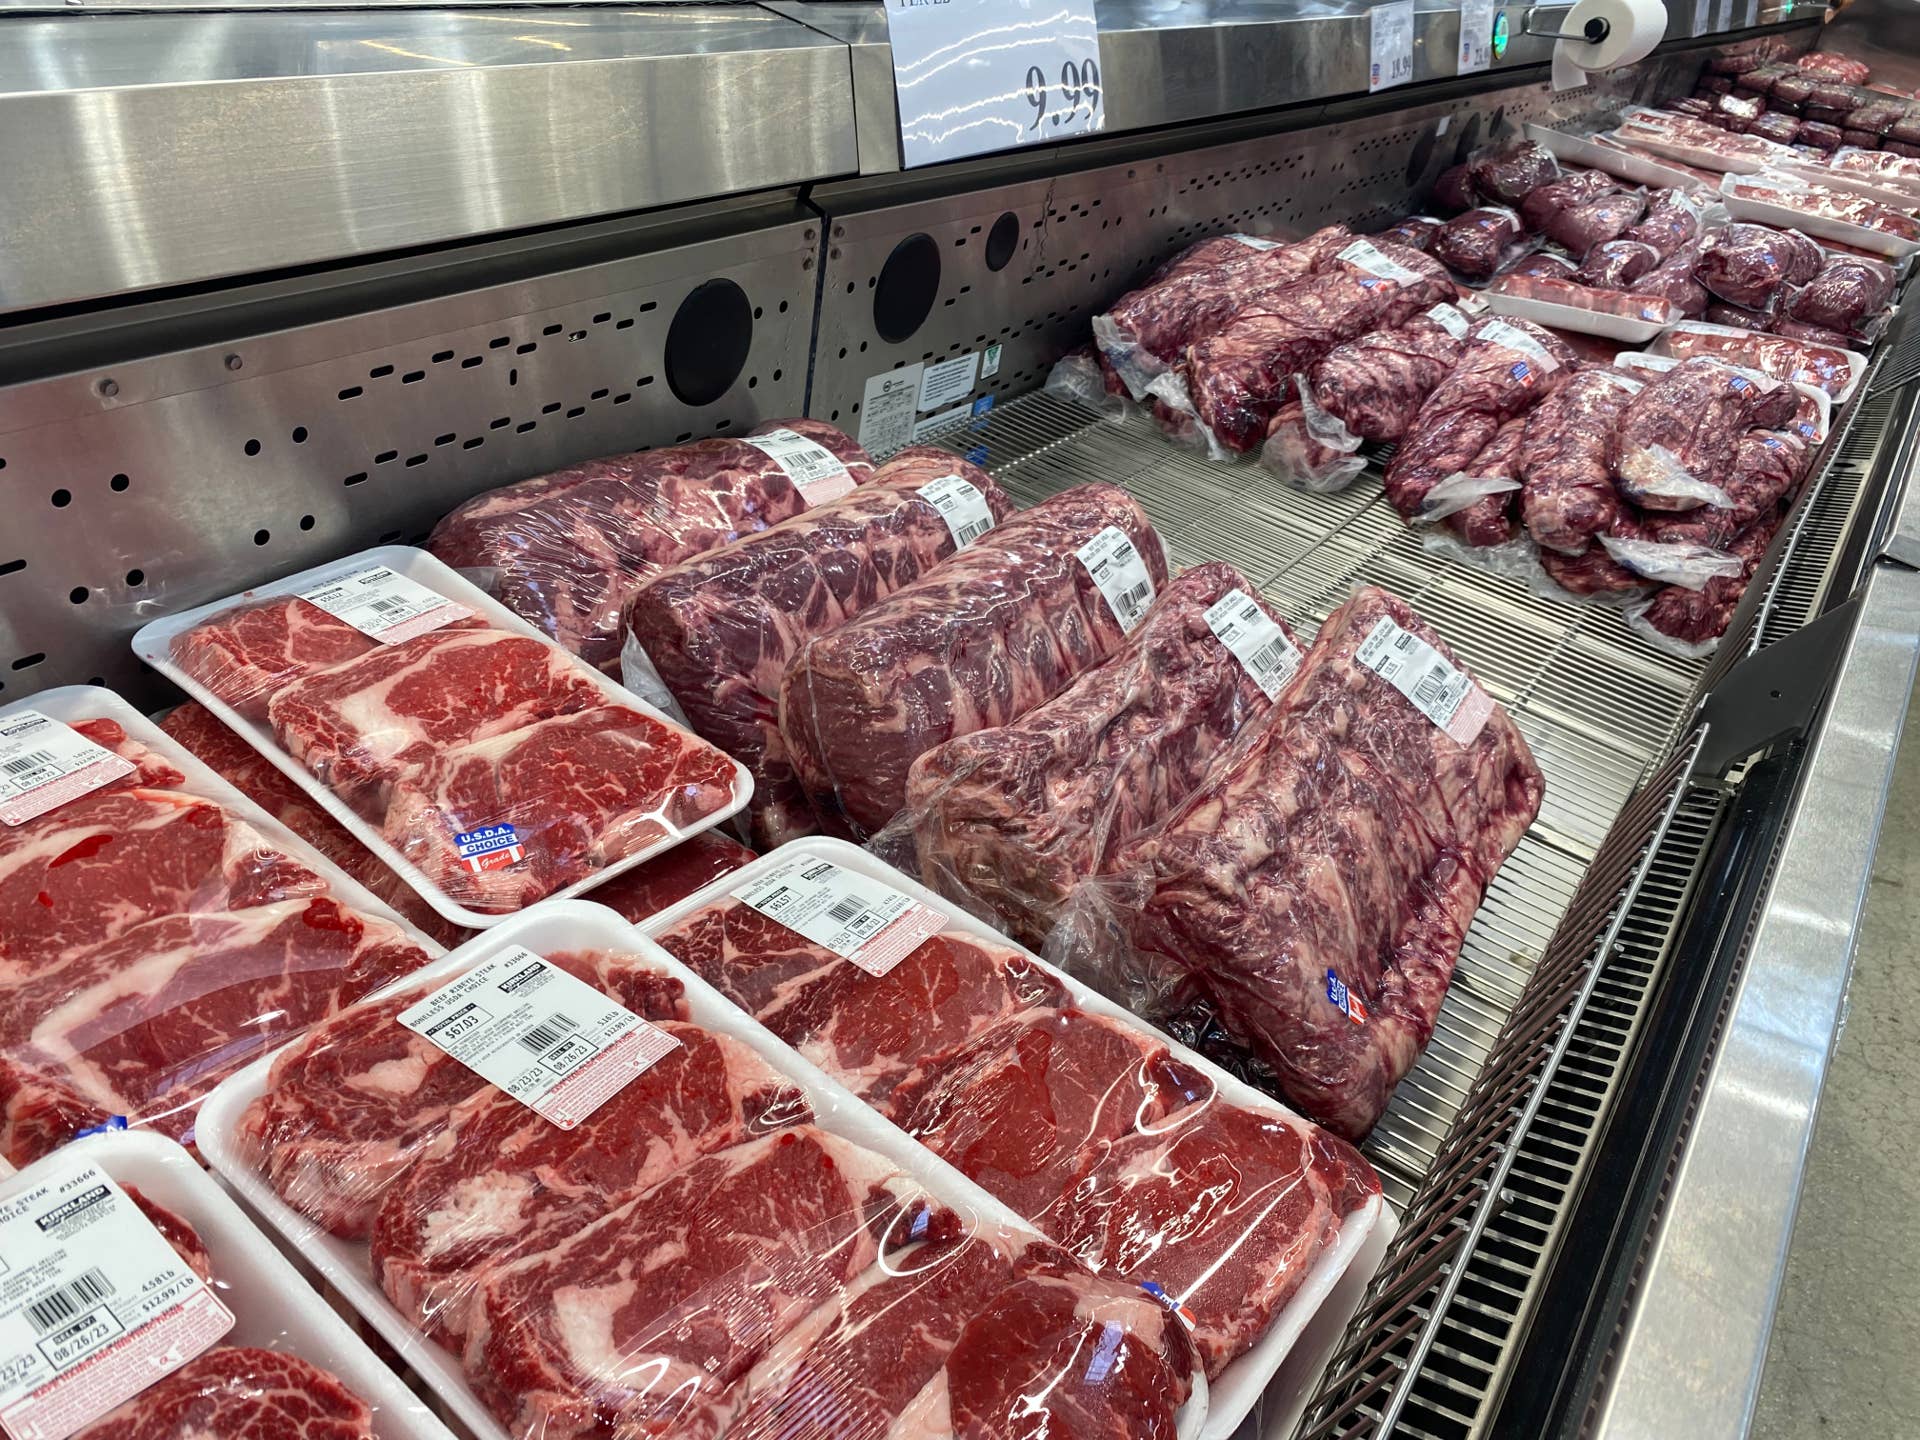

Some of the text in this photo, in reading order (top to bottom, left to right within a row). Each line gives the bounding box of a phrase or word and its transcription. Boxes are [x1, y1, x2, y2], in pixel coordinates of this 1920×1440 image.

[1026, 58, 1100, 130] 9.99
[461, 827, 510, 843] U.S.D.A.
[466, 836, 514, 852] CHOICE
[481, 853, 510, 869] Grade
[430, 964, 497, 1006] BEEF RIBEYE STEAK
[500, 963, 541, 990] KIRKLAND
[410, 977, 488, 1028] BONELESS USDA CHOICE
[445, 1015, 479, 1040] $67.03
[554, 1045, 588, 1070] 08/26/23
[508, 1067, 544, 1094] 08/23/23
[59, 1169, 96, 1193] #33666
[16, 1187, 48, 1206] STEAK
[40, 1186, 105, 1226] KIRKLAND
[141, 1270, 175, 1292] 4.58lb
[142, 1277, 194, 1312] $12.99/lb
[54, 1324, 110, 1362] 08/26/23
